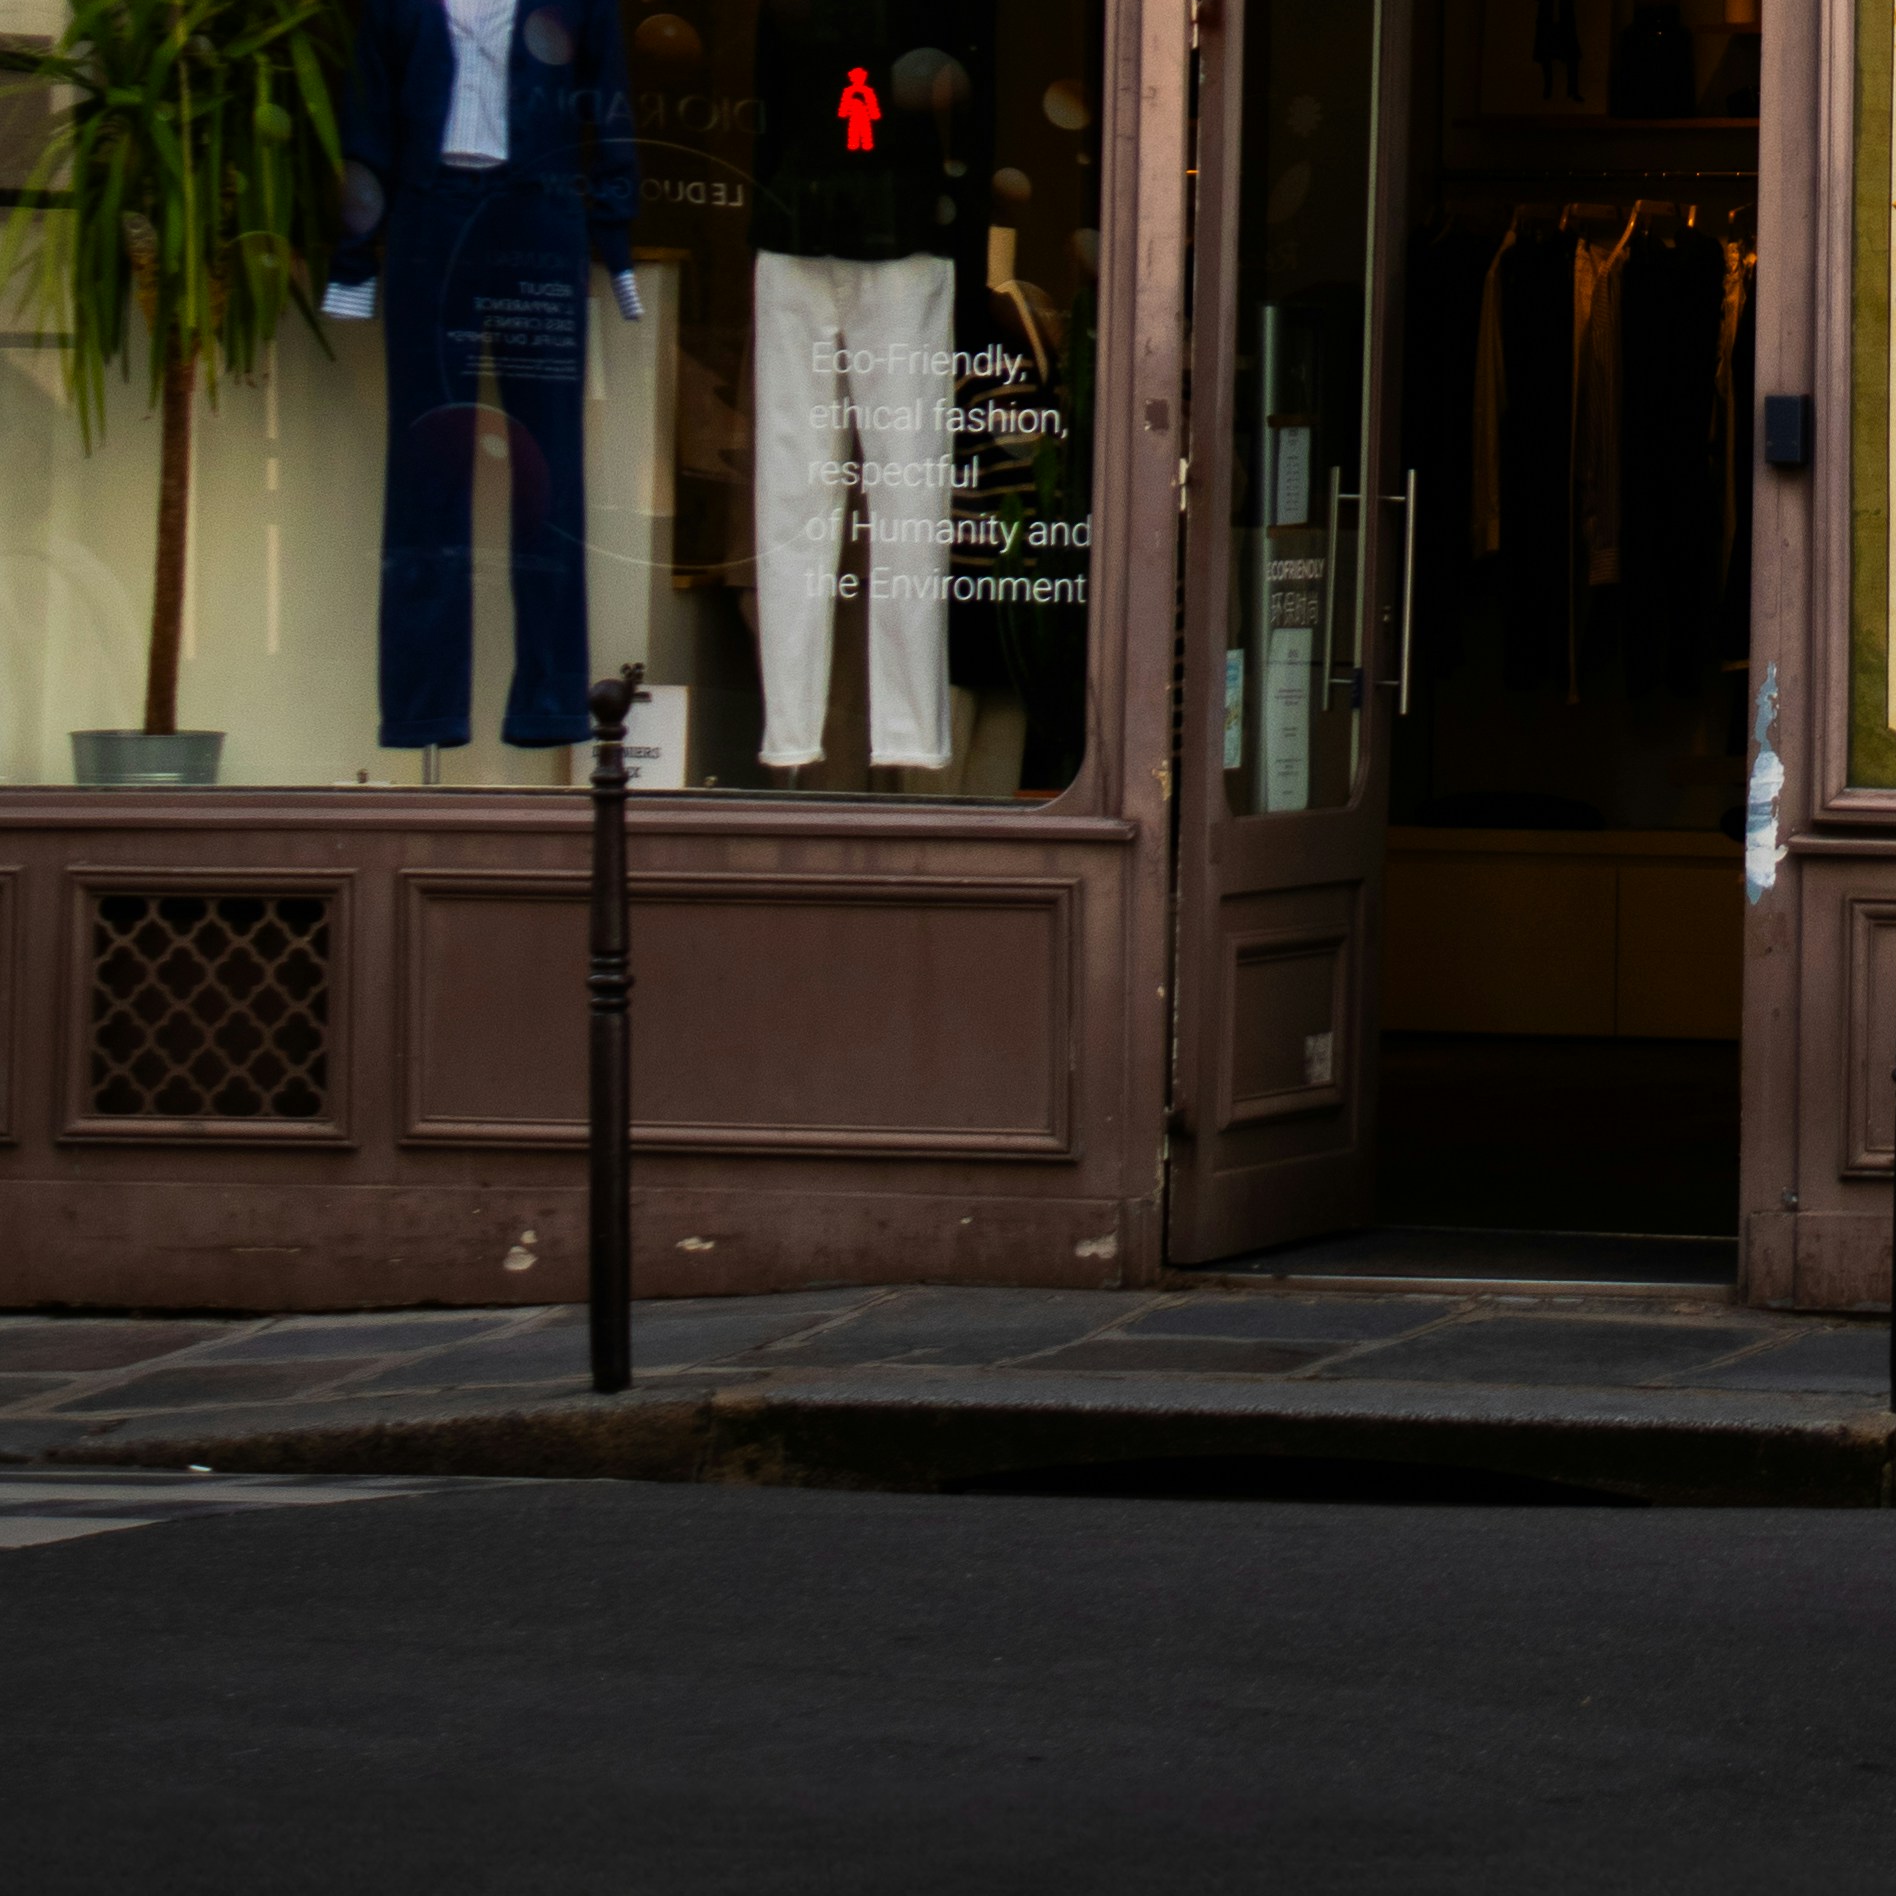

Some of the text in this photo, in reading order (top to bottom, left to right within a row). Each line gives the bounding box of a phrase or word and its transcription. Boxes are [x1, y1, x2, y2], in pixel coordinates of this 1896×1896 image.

[812, 341, 1027, 385] Eco-Friendly,
[809, 397, 1069, 439] ethical fashion,
[808, 454, 979, 495] respectful
[805, 507, 1093, 555] of Humanity and
[804, 564, 1088, 604] the Environment
